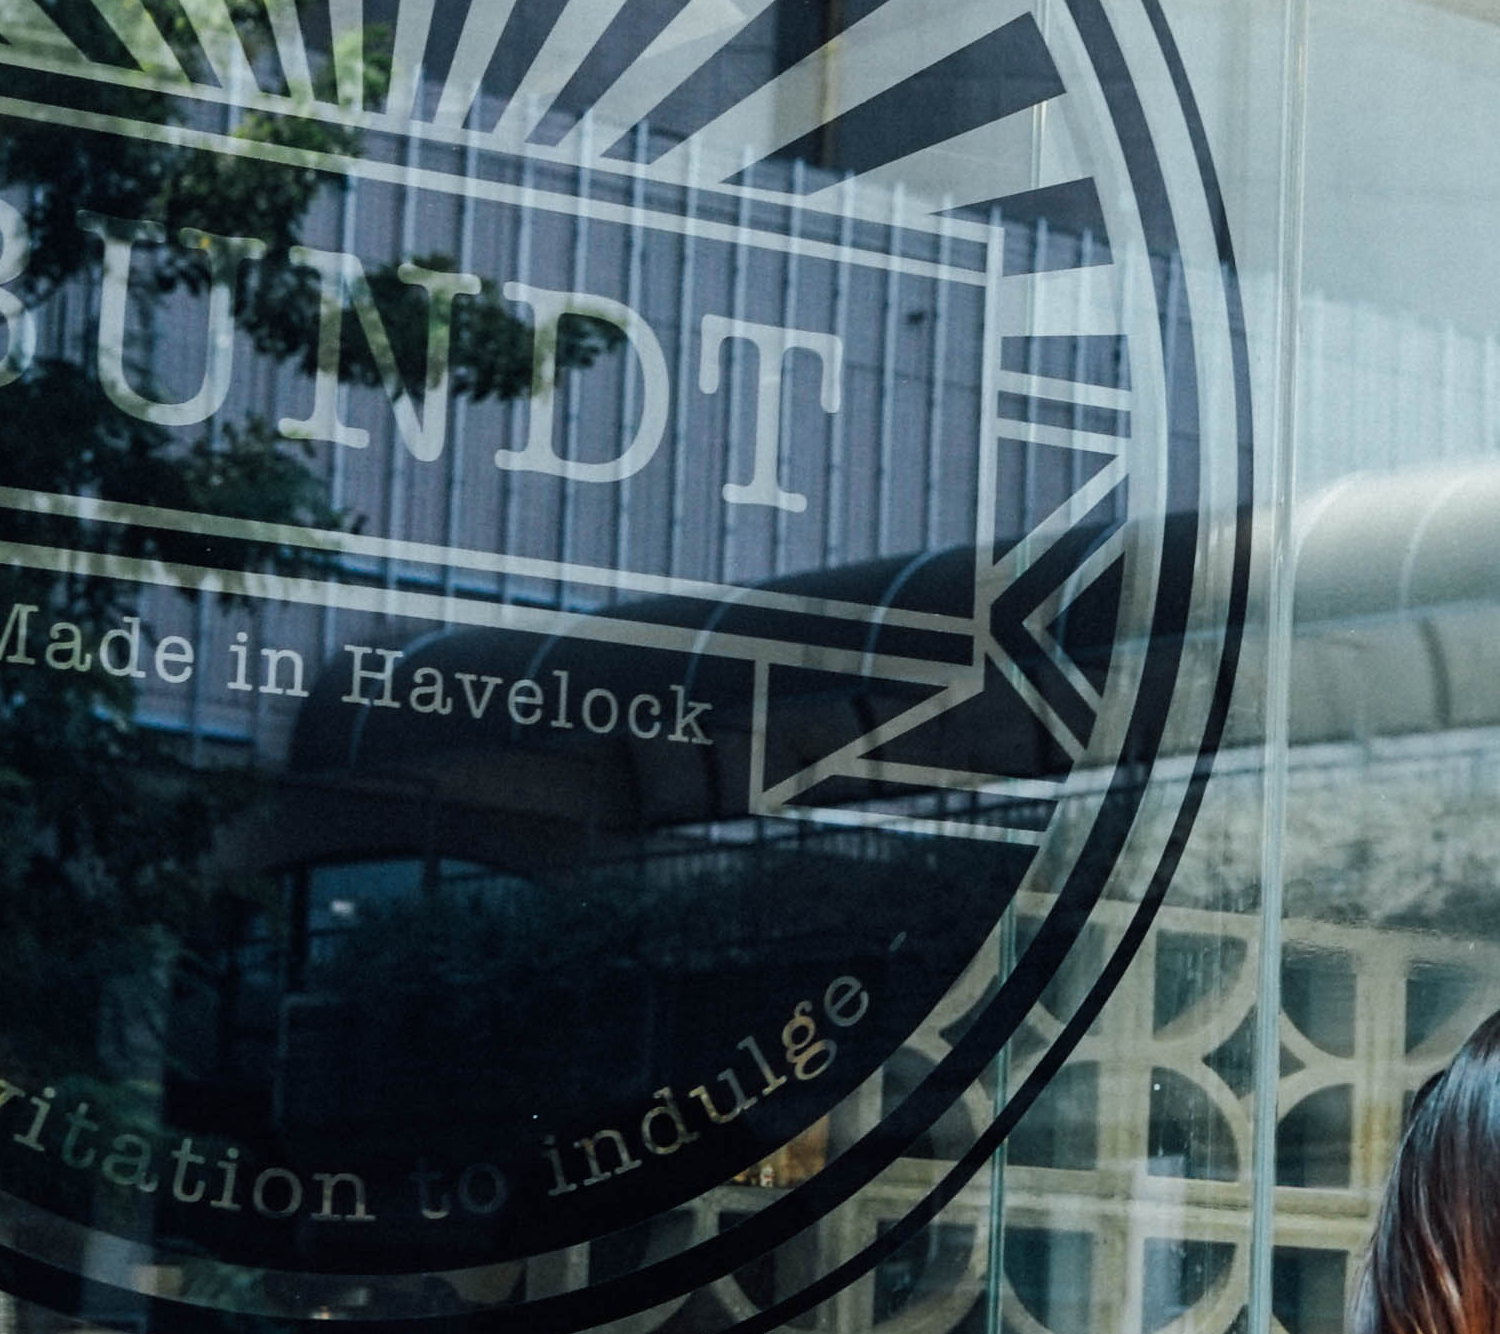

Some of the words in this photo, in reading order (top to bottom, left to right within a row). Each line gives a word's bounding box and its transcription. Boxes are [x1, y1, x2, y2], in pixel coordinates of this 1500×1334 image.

[225, 629, 312, 698] in
[342, 644, 717, 747] Havelock
[411, 1161, 508, 1221] to
[541, 974, 870, 1197] indulge
